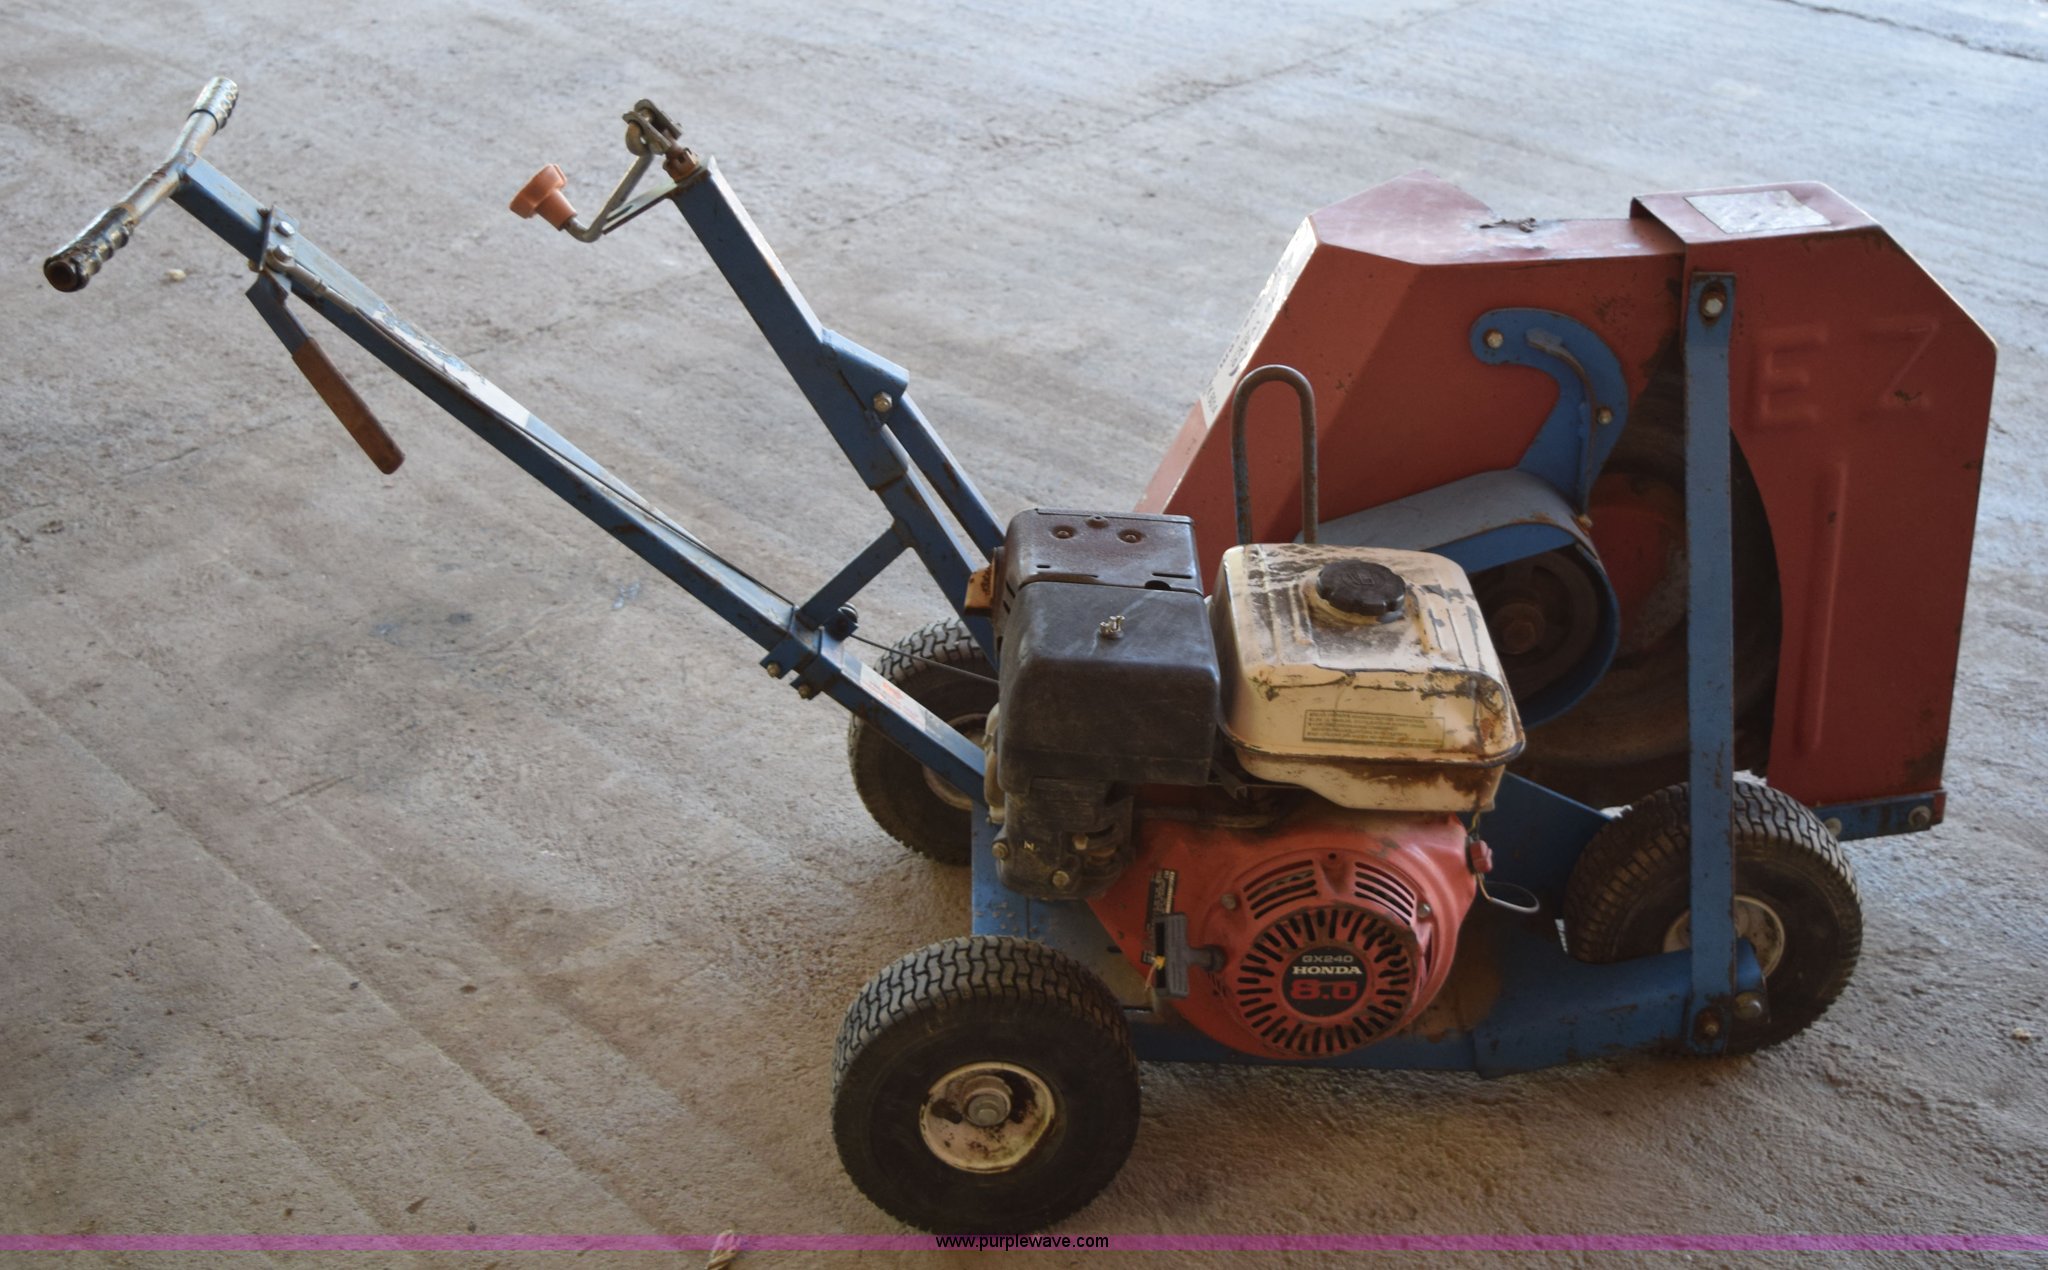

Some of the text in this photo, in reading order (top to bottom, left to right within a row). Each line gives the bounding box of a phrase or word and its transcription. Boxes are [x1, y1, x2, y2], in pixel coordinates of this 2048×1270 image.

[1752, 316, 1940, 430] EZ
[1302, 955, 1354, 963] GX240
[1293, 966, 1362, 975] HONDA
[1291, 980, 1358, 1000] 8.0
